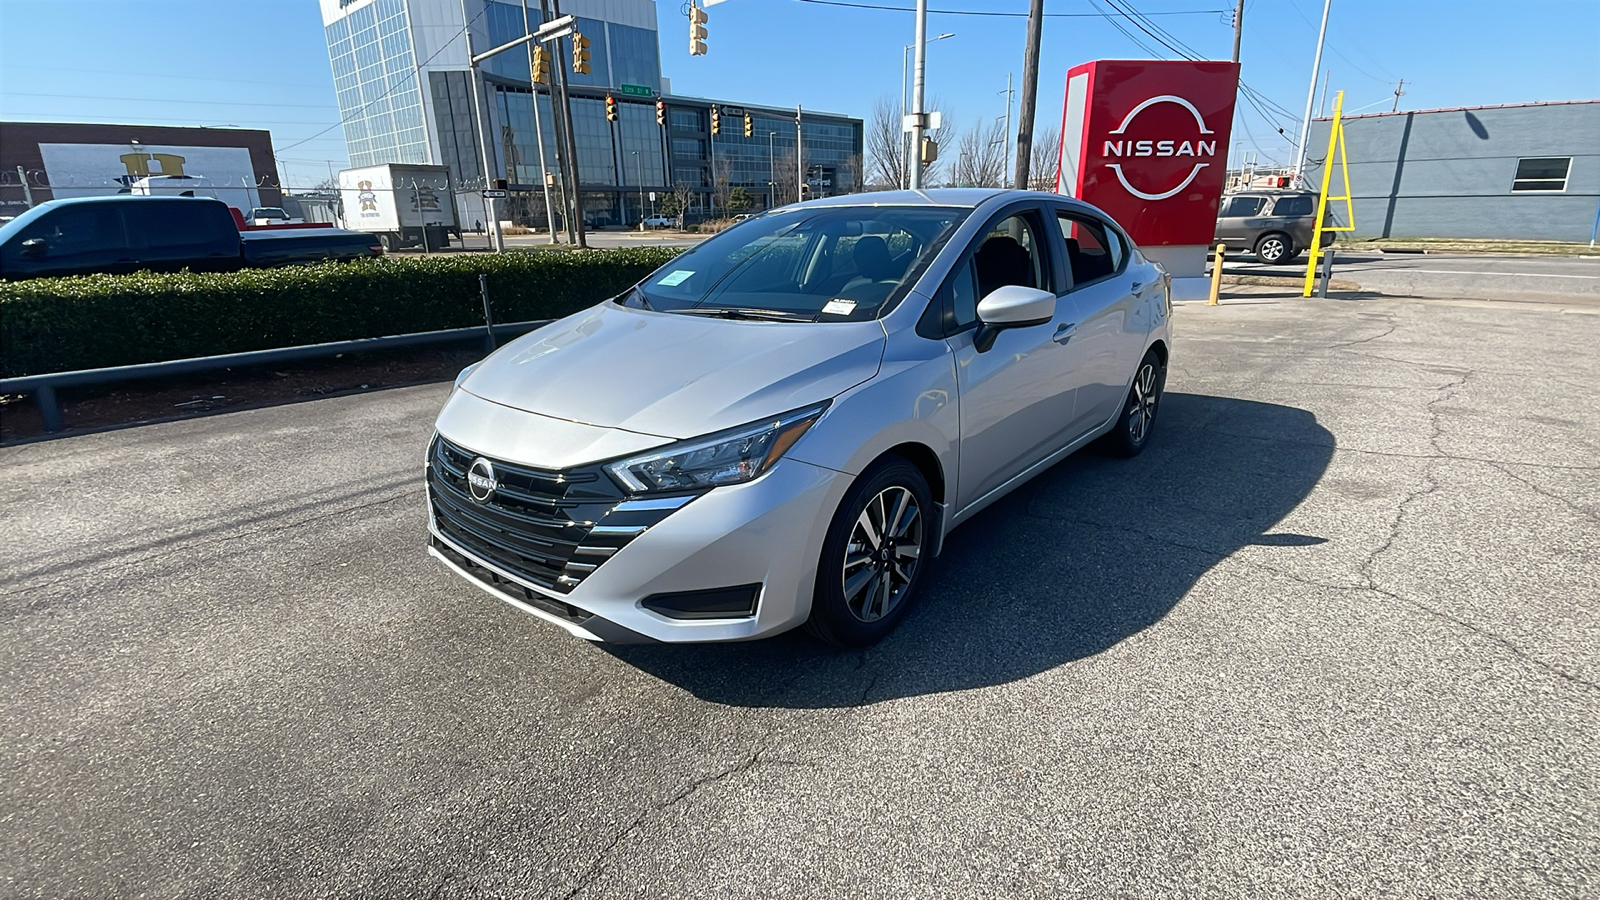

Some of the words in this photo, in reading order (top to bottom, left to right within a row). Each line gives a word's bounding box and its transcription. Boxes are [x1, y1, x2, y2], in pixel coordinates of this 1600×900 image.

[1103, 140, 1217, 157] NISSAN
[806, 178, 832, 186] AmFrst
[467, 471, 498, 491] SSAN
